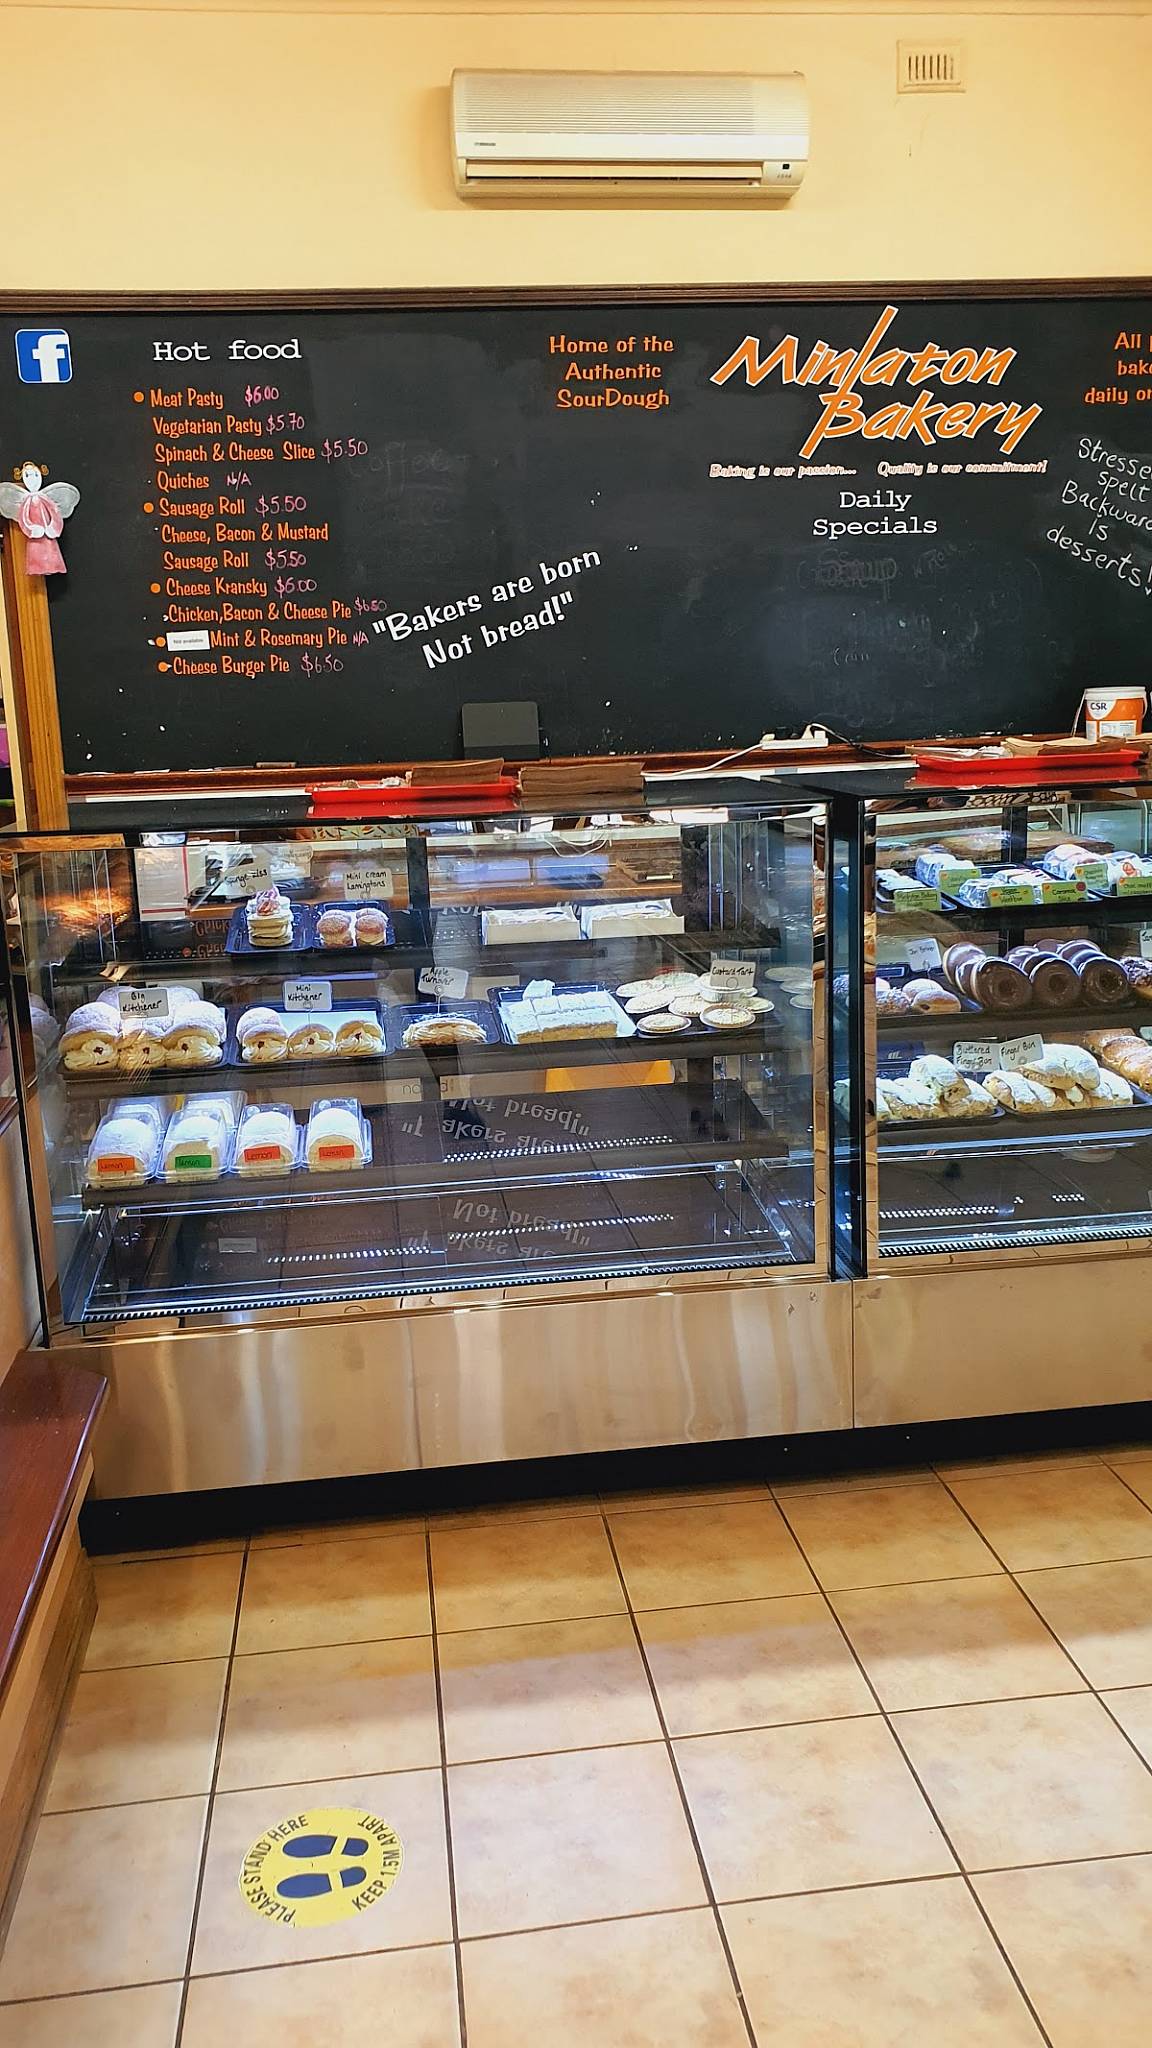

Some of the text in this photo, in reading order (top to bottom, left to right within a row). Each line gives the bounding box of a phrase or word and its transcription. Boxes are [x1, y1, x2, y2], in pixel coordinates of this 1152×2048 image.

[153, 339, 302, 361] Hot food
[549, 335, 674, 353] Home of the
[710, 304, 1017, 390] Minlaton
[1114, 332, 1141, 350] All
[565, 362, 662, 381] Authentic
[150, 385, 279, 410] Meat Pasty $6.00
[557, 388, 669, 410] SourDough
[1084, 387, 1128, 404] daily
[153, 417, 222, 438] Vegetarian
[226, 415, 263, 436] Pasty
[799, 389, 1043, 460] Bakery
[155, 438, 368, 466] Spinach & Cheese Slice $5.50
[710, 463, 755, 479] Baking
[759, 465, 770, 477] is
[774, 466, 795, 477] our
[878, 460, 1048, 477] Quality is our commitment!
[157, 471, 252, 492] Quiches N/A
[1098, 471, 1150, 502] spelt
[159, 495, 307, 520] Sausage Roll $5.50
[840, 490, 912, 512] Daily
[161, 522, 329, 544] Cheese, Bacon & Mustard
[813, 517, 937, 540] Specials
[1089, 514, 1108, 540] is
[163, 551, 218, 573] Sausage
[223, 550, 249, 568] Roll
[166, 576, 317, 598] Cheese Kransky $6.00
[372, 550, 601, 641] "Bakers are born
[268, 603, 280, 621] &
[283, 602, 328, 620] Cheese
[332, 600, 352, 619] Pie
[210, 627, 369, 649] Mint & Rosemary Pie N/A
[422, 590, 573, 669] Not bread!"
[173, 652, 344, 678] Cheese Burger Pie $6.50
[1090, 702, 1107, 711] CSR
[243, 1815, 309, 1924] PLEASE STAND HERE
[352, 1815, 400, 1912] KEEP 1.5M APART
